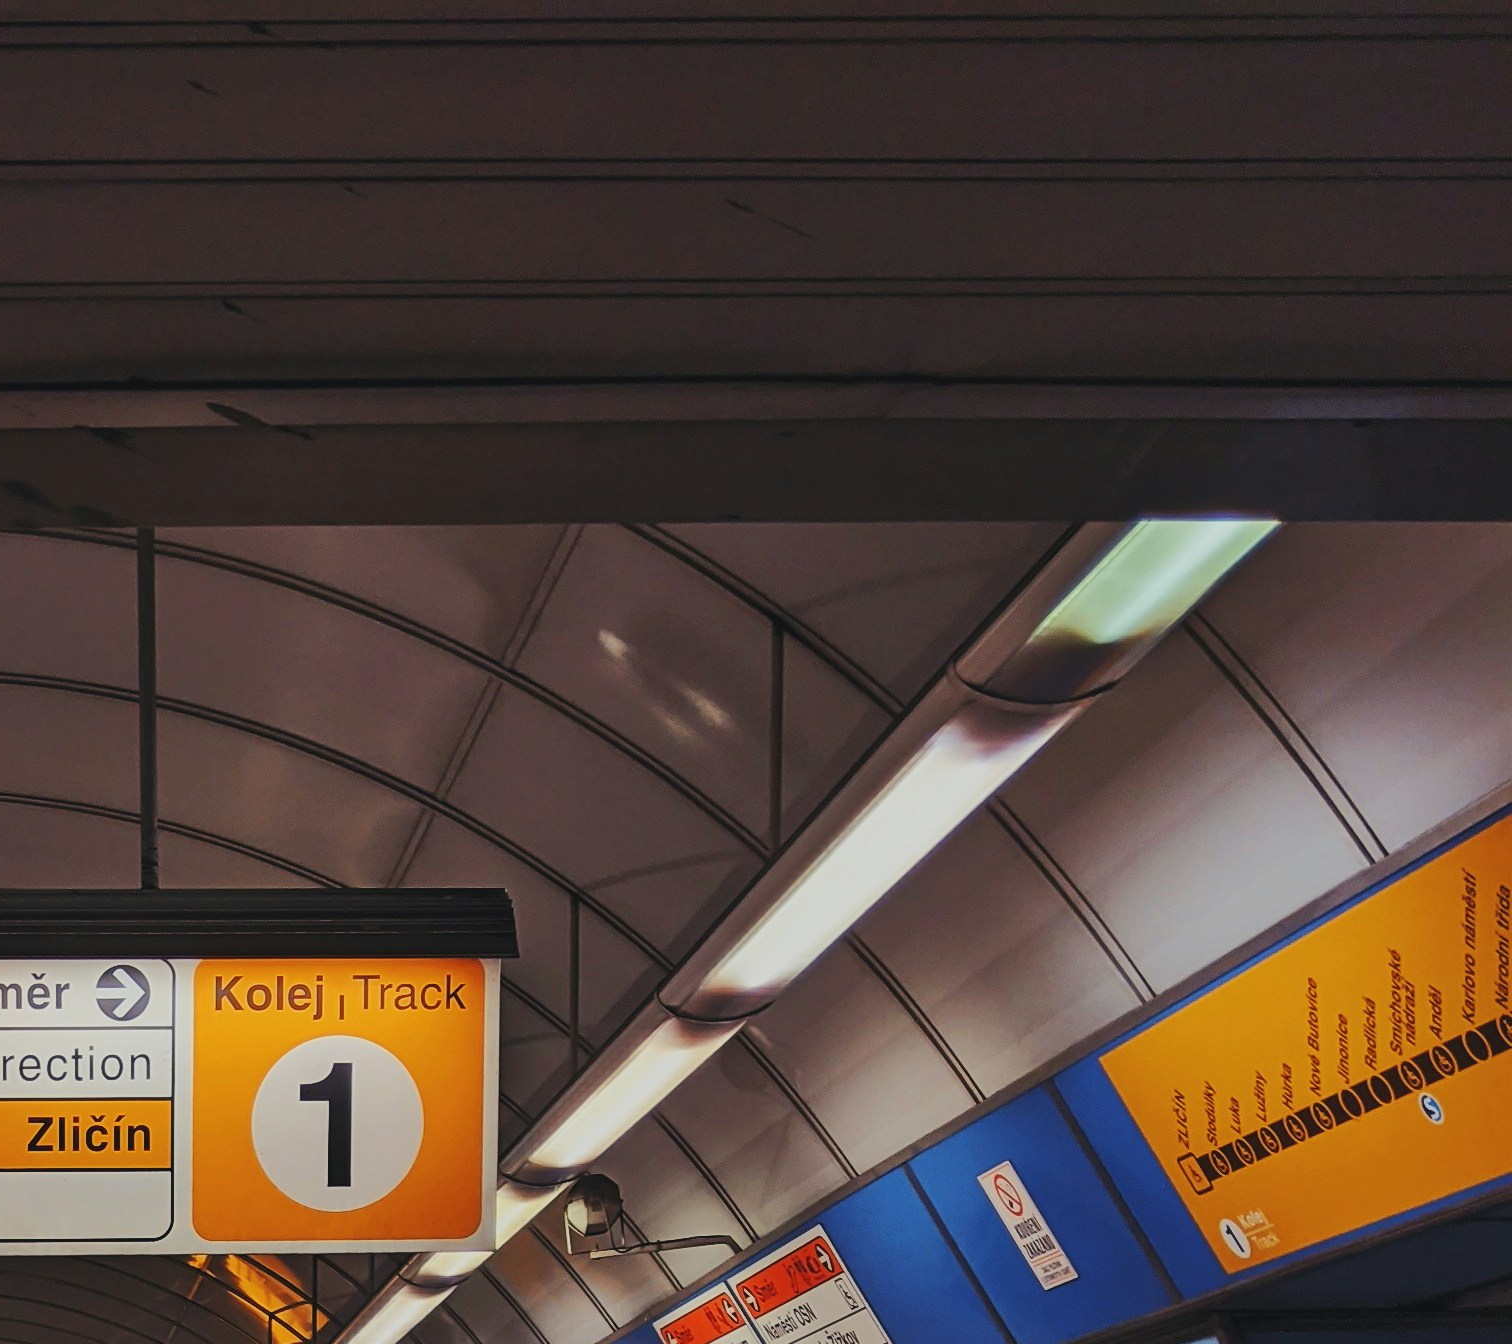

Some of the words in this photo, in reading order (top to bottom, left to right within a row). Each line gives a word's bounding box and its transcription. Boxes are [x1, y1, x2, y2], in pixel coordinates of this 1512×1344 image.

[1461, 868, 1477, 950] náměstí
[214, 974, 324, 1020] Kolej
[352, 974, 466, 1010] Track
[1306, 977, 1320, 1052] Butovice
[1388, 946, 1404, 1056] Smíchovské
[1428, 984, 1443, 1041] Anděl
[1461, 953, 1476, 1025] Karlovo
[1336, 1013, 1350, 1085] Jinonice
[1362, 994, 1377, 1071] Radlická
[1254, 1070, 1268, 1123] Lužiny
[1307, 1052, 1322, 1096] Nové
[26, 1114, 151, 1152] Zličín
[299, 1062, 353, 1187] 1
[1173, 1088, 1190, 1151] ZLIČÍN
[1229, 1096, 1242, 1136] Luka
[1225, 1223, 1246, 1254] 1
[762, 1312, 799, 1341] Náměstí
[793, 1302, 818, 1327] OSN
